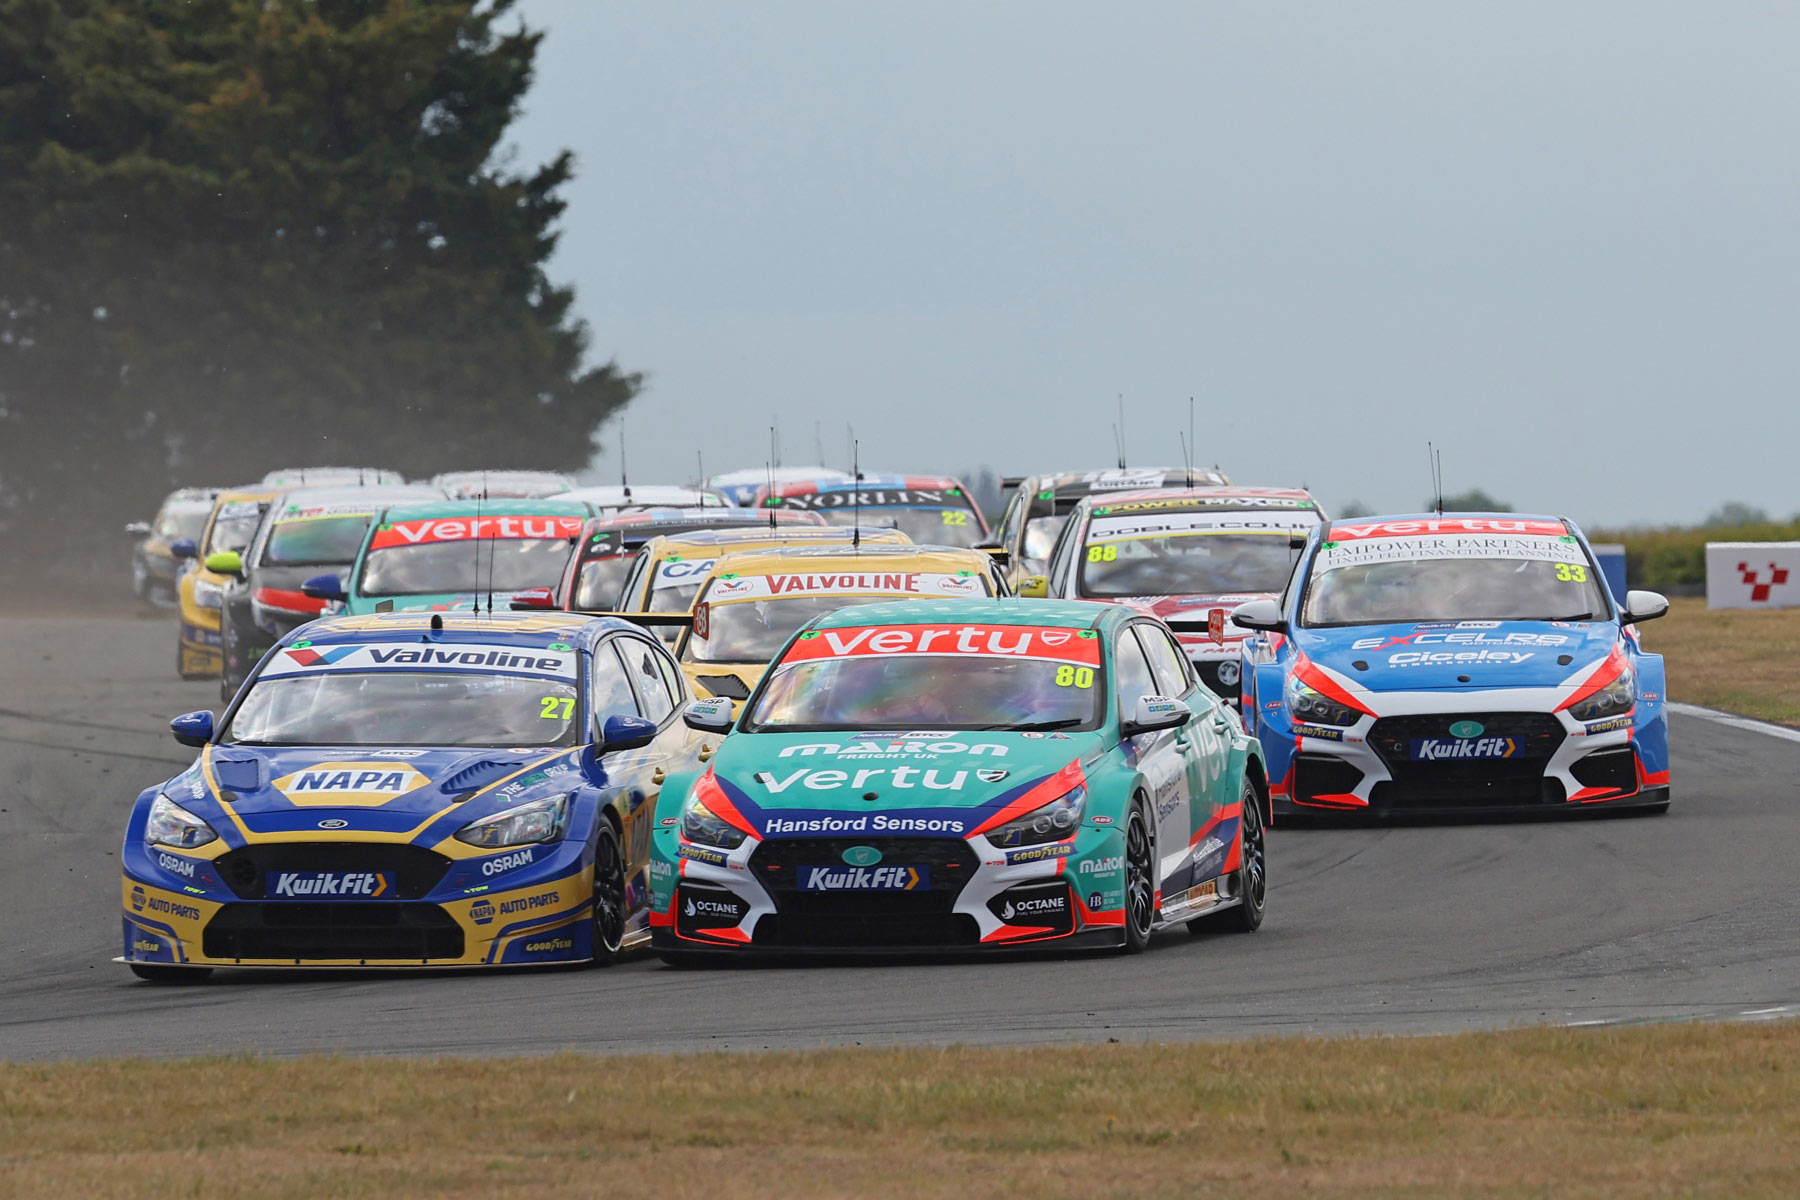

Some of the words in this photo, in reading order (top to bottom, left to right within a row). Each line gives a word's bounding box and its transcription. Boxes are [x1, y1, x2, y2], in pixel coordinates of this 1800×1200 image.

[941, 511, 967, 525] 22
[395, 517, 555, 542] vertu
[1343, 519, 1526, 538] vertu
[1088, 545, 1117, 562] 88
[1328, 540, 1446, 558] EMPOWER
[1456, 539, 1576, 554] PARTNERS
[1328, 553, 1373, 566] FIXED
[1411, 548, 1496, 557] FINANCIAL
[1498, 549, 1576, 561] PLANNING
[1555, 563, 1587, 582] 33
[765, 573, 921, 594] VALVOLINE
[824, 627, 1032, 655] vertu
[369, 648, 563, 671] Valvoline
[1388, 650, 1536, 665] Ciceley
[1056, 665, 1094, 689] 80
[540, 696, 576, 720] 27
[1292, 726, 1338, 739] GOODYEAR
[1590, 718, 1633, 733] GOODYEAR
[295, 771, 405, 790] NAPA
[759, 765, 969, 793] vertu
[765, 817, 867, 834] Hansford
[871, 815, 964, 833] Sensors
[482, 849, 533, 876] OSRAM
[680, 845, 723, 863] GOODYEAR
[1013, 845, 1071, 861] GOODYEAR
[158, 853, 195, 878] OSRAM
[148, 897, 170, 913] AUTO
[171, 903, 201, 921] PARTS
[499, 898, 528, 915] AUTO
[529, 892, 560, 909] PARTS
[696, 900, 738, 914] OCTANE
[1016, 897, 1065, 911] OCTANE
[526, 938, 572, 951] GOODYEAR
